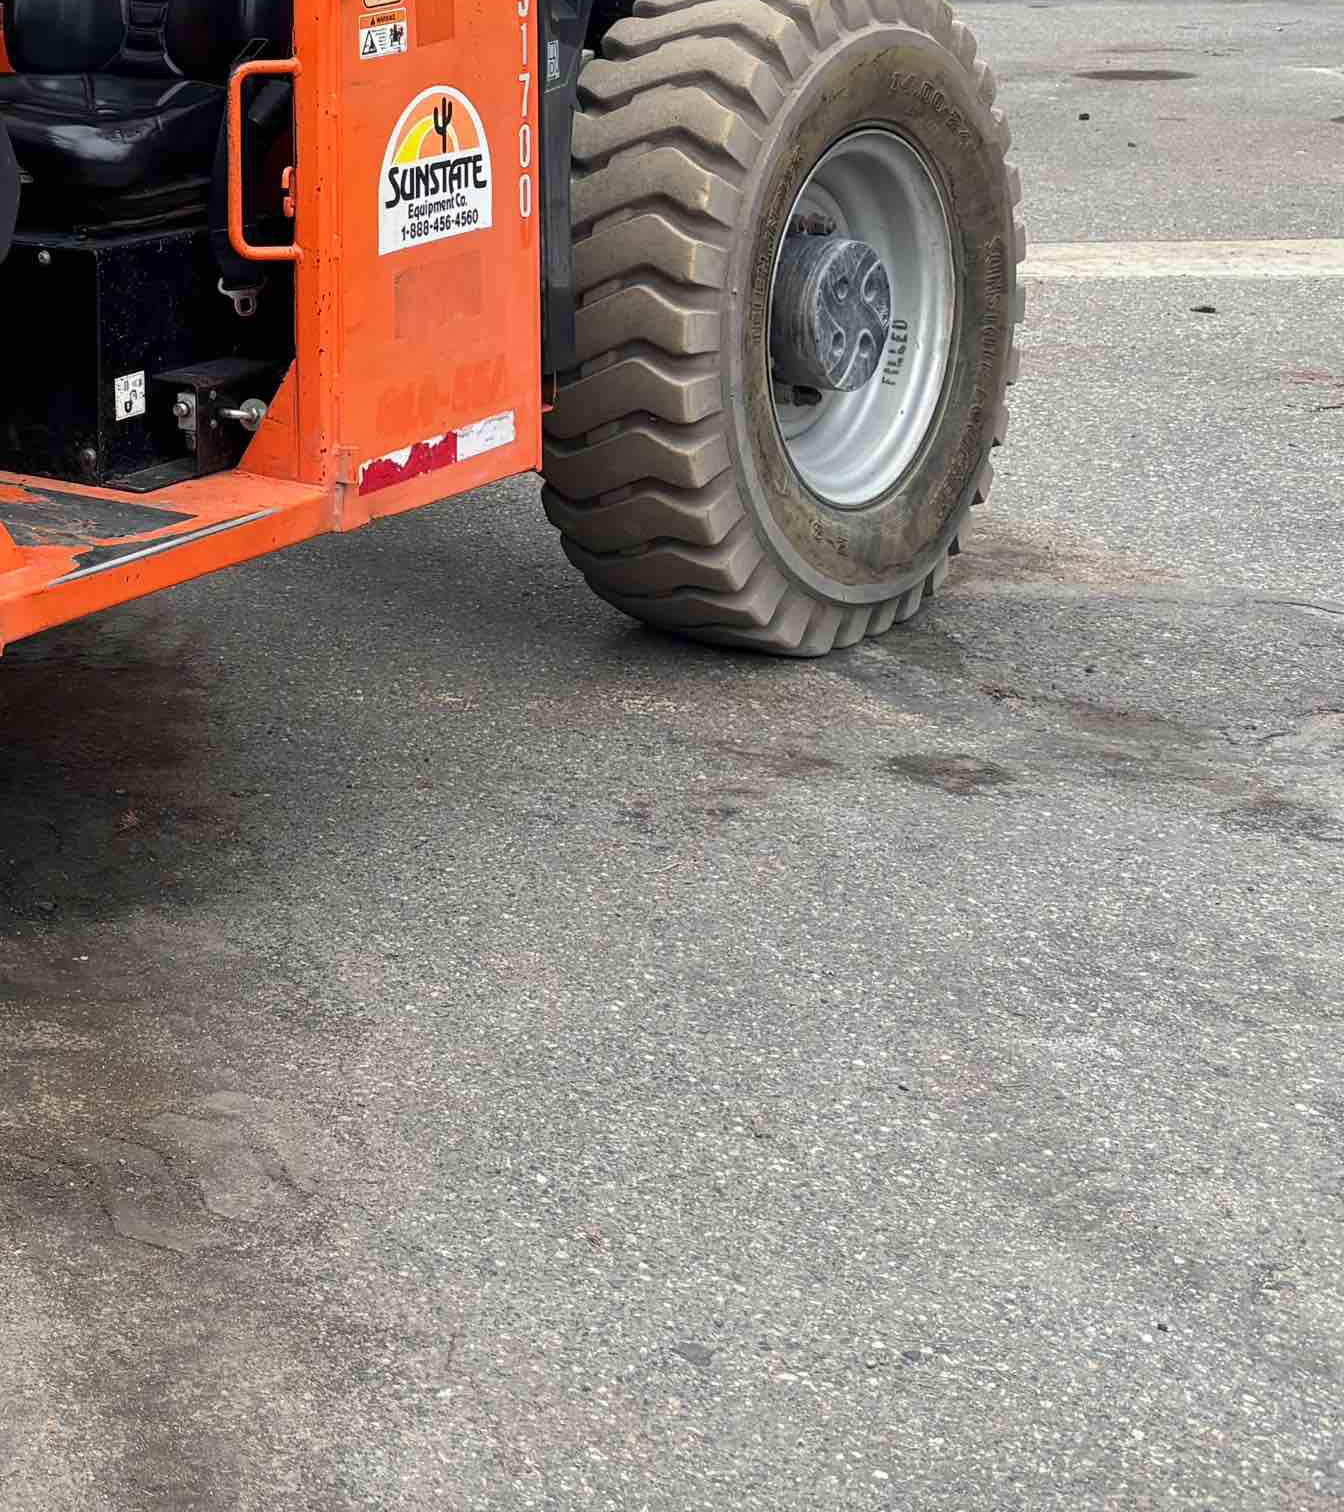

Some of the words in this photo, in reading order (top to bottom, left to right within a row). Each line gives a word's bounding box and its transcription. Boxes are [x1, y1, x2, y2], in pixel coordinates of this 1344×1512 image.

[385, 154, 487, 209] SUNSTATE
[401, 208, 479, 241] 1-888-456-4560
[408, 195, 455, 220] Equipment
[455, 192, 468, 207] Co.
[881, 319, 909, 386] FILLED
